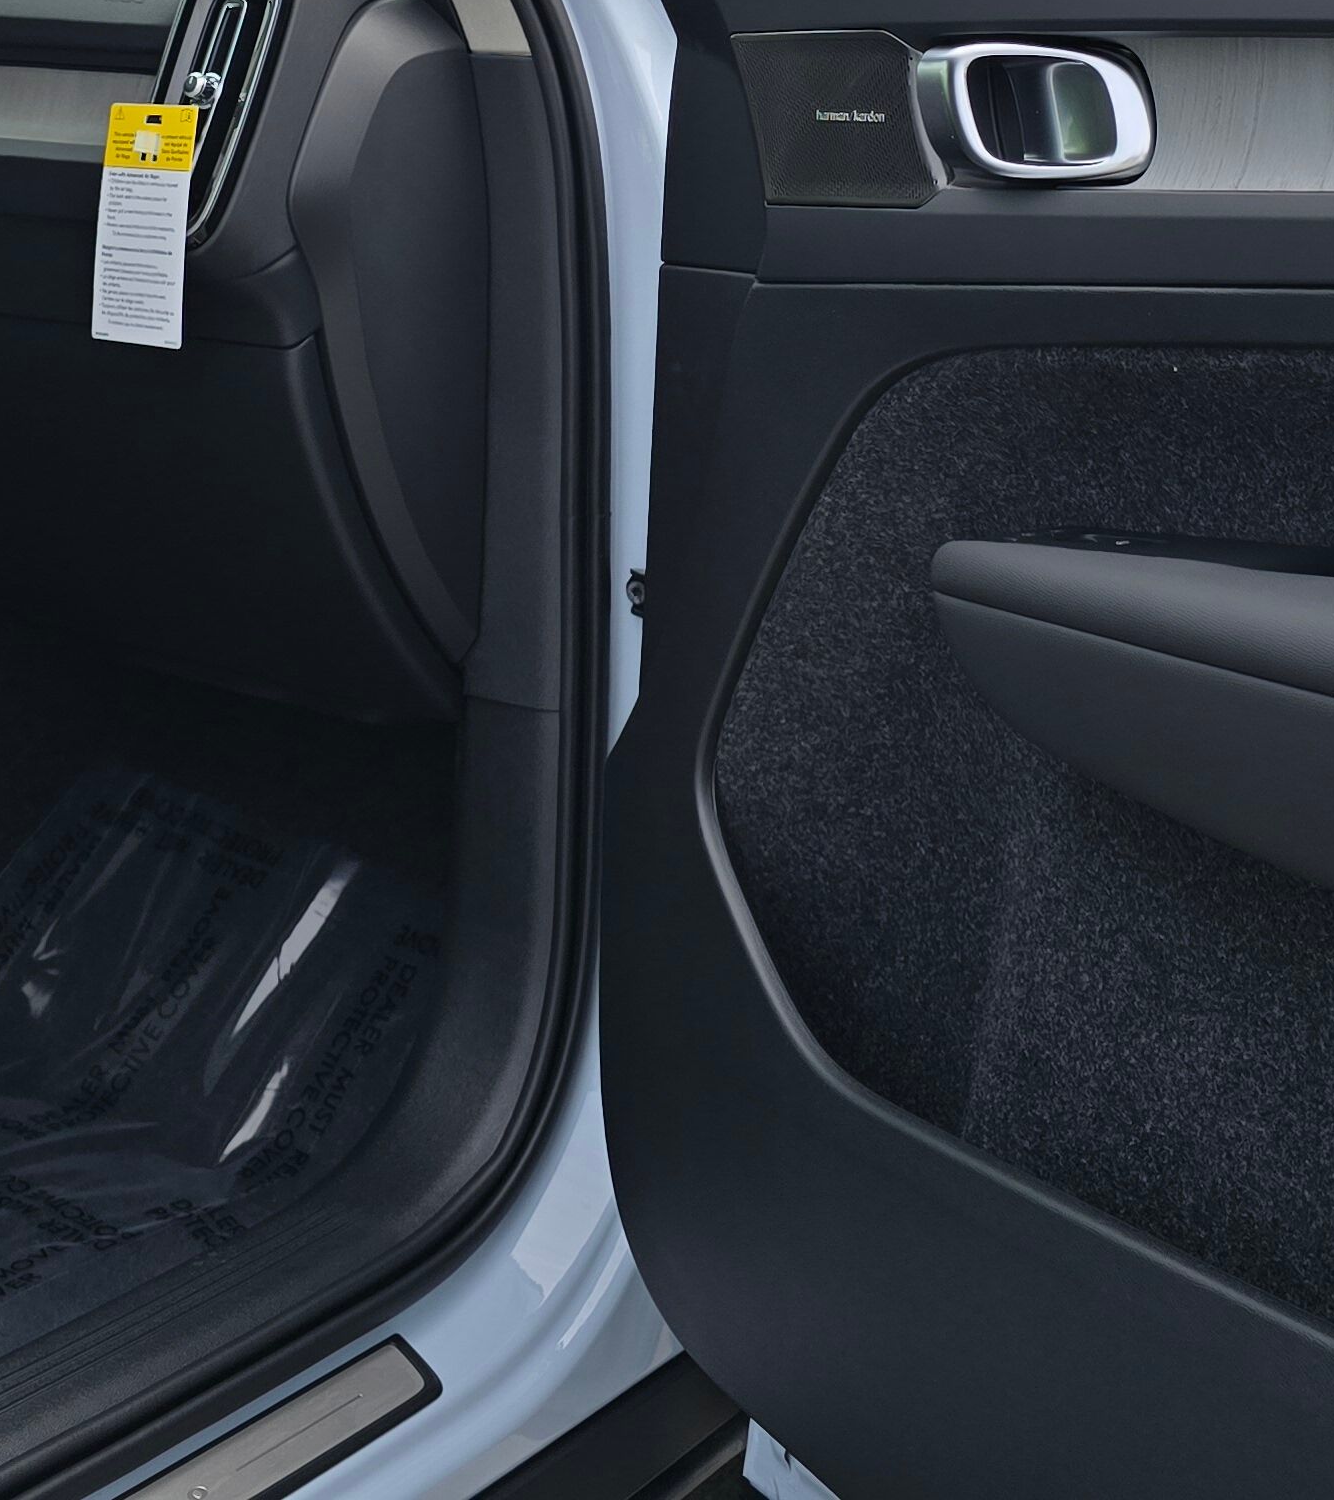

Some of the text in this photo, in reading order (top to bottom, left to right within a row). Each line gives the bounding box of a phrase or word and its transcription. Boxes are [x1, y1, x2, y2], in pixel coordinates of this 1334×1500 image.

[816, 109, 885, 122] harman/kardon
[154, 938, 218, 1020] COVER
[350, 959, 422, 1058] DEALER
[297, 952, 403, 1104] PROTECTIVE
[302, 1064, 360, 1139] MUST
[239, 1103, 310, 1181] COVER
